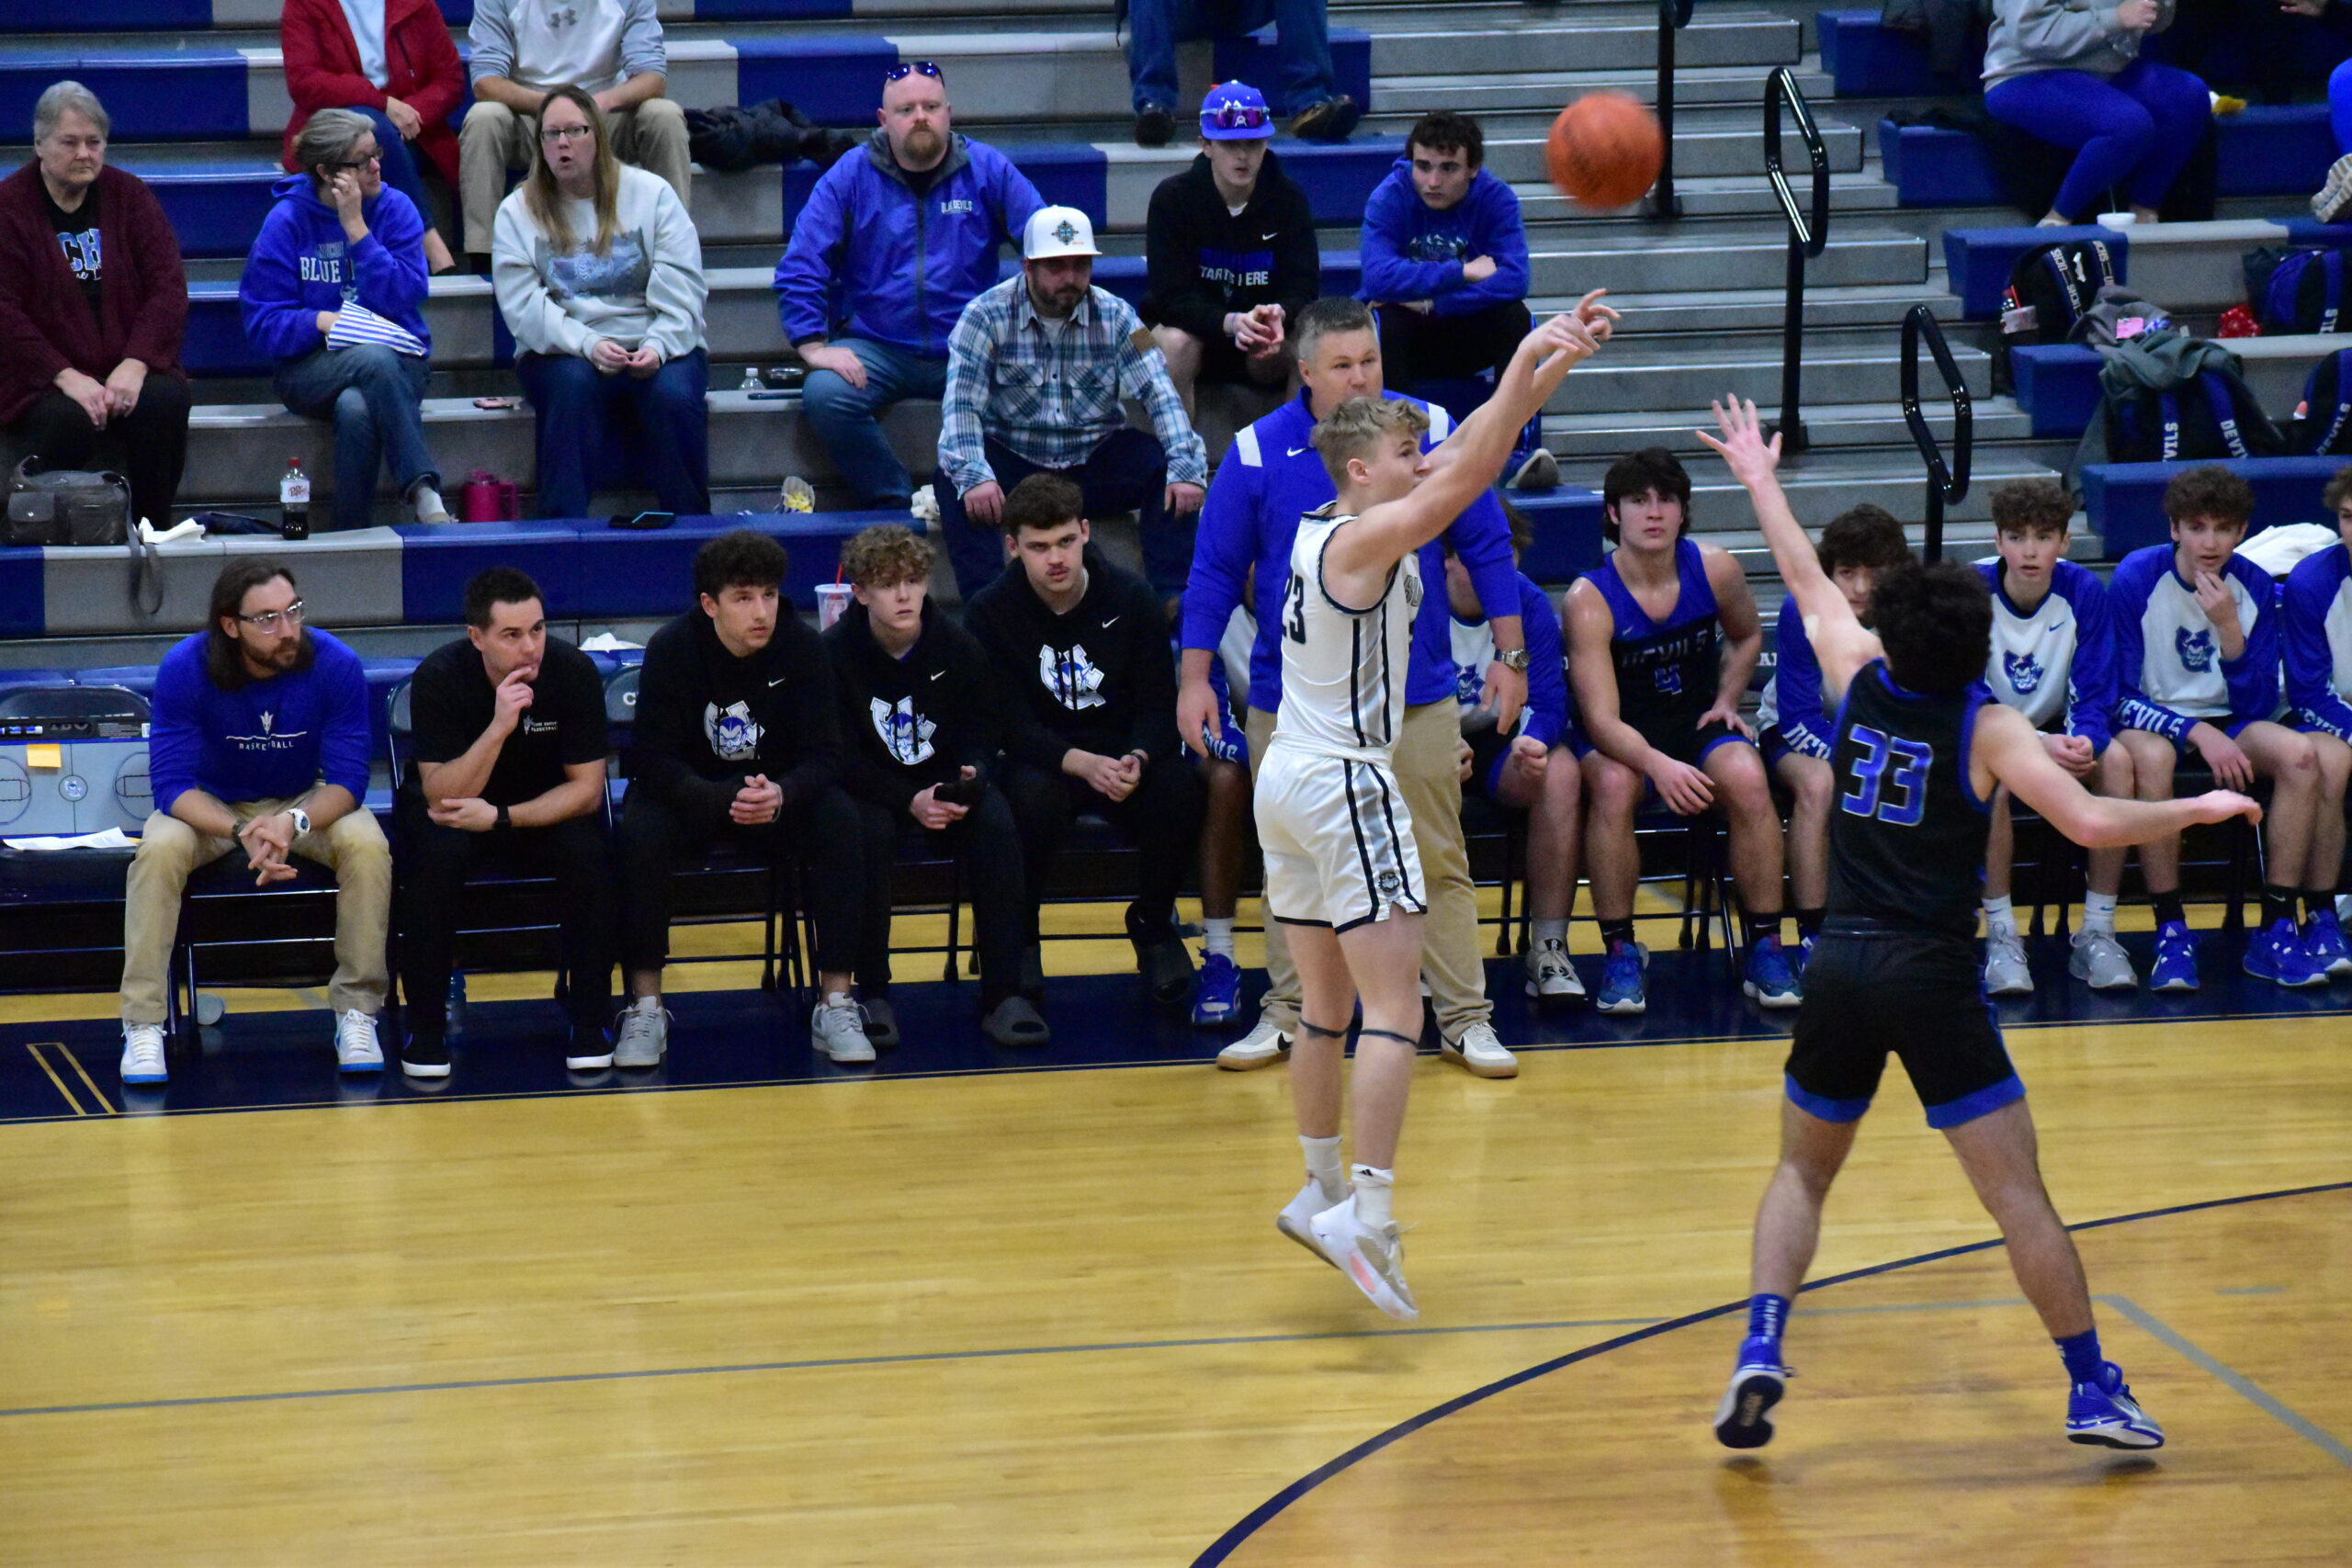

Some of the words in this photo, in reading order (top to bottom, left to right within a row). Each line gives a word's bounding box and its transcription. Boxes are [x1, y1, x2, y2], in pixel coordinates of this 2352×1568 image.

[300, 256, 342, 284] BLUE
[2162, 422, 2180, 463] VILS
[1841, 723, 1935, 827] 33
